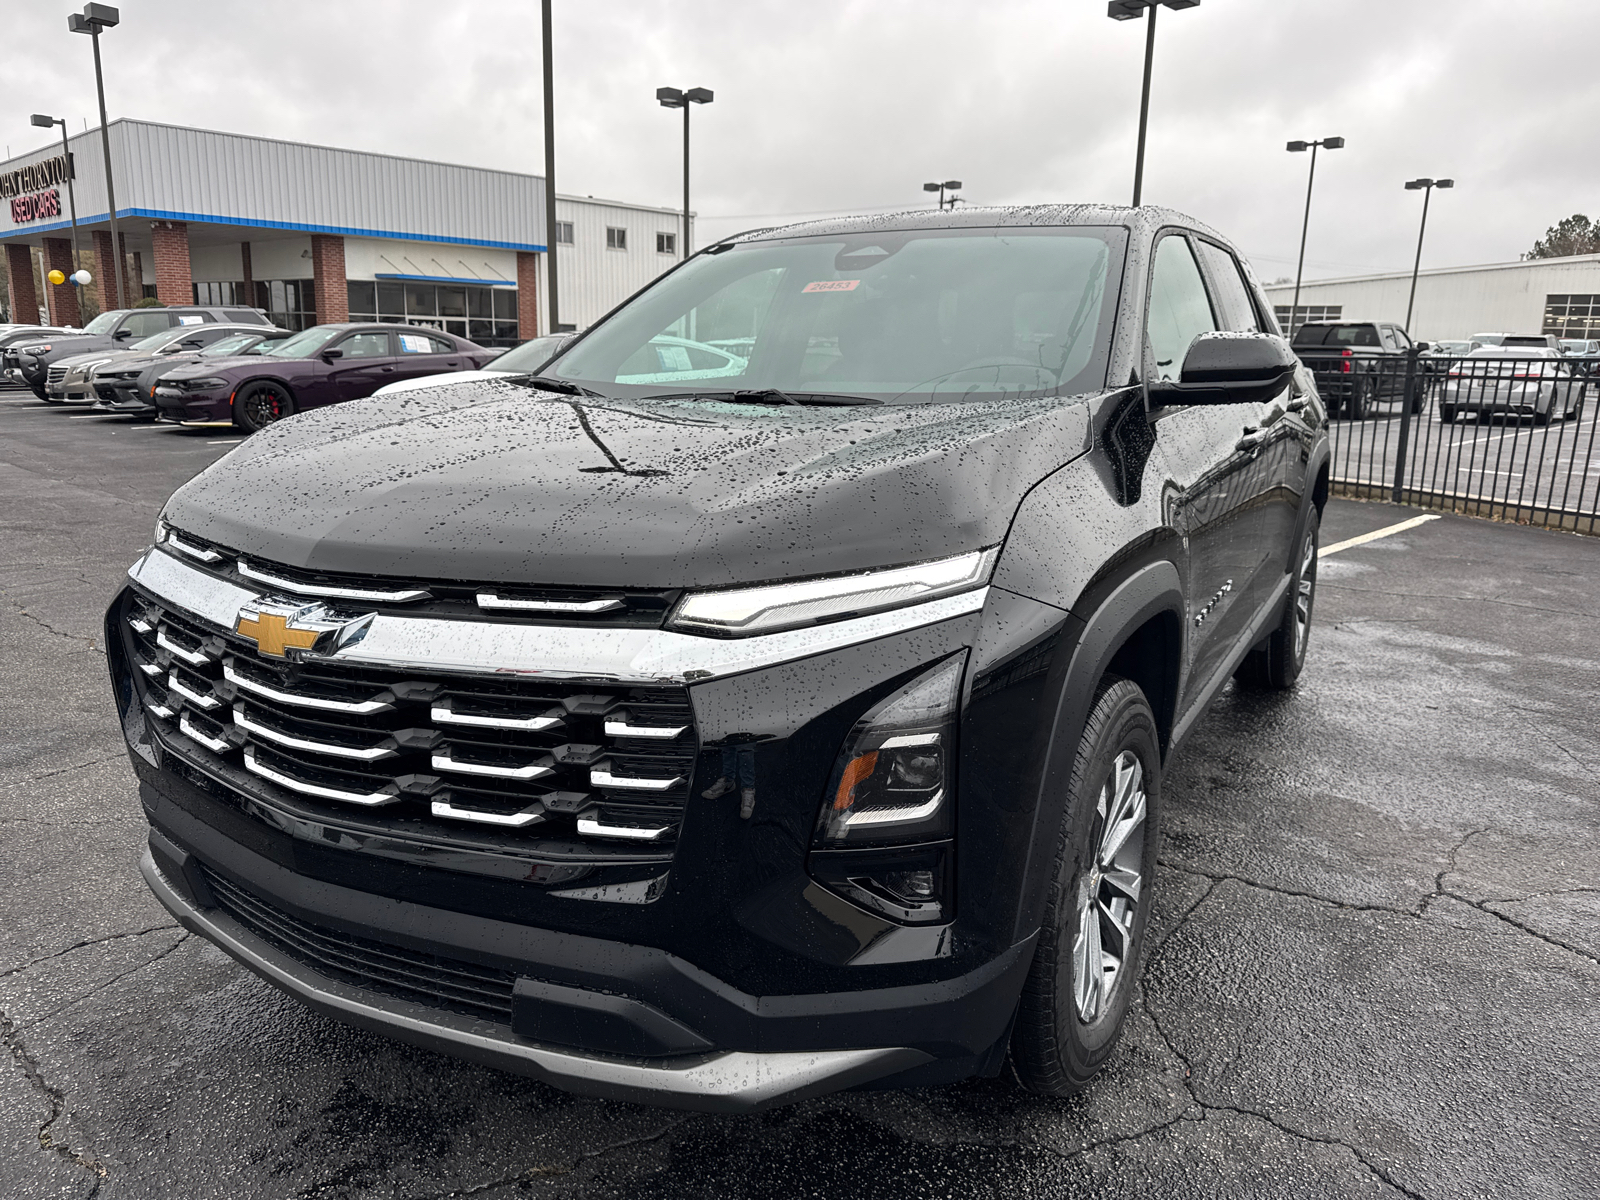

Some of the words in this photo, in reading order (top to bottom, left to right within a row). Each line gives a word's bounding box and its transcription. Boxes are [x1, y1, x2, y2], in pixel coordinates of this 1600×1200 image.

[10, 196, 32, 223] USED
[33, 189, 58, 219] CARS
[810, 282, 851, 291] 26453
